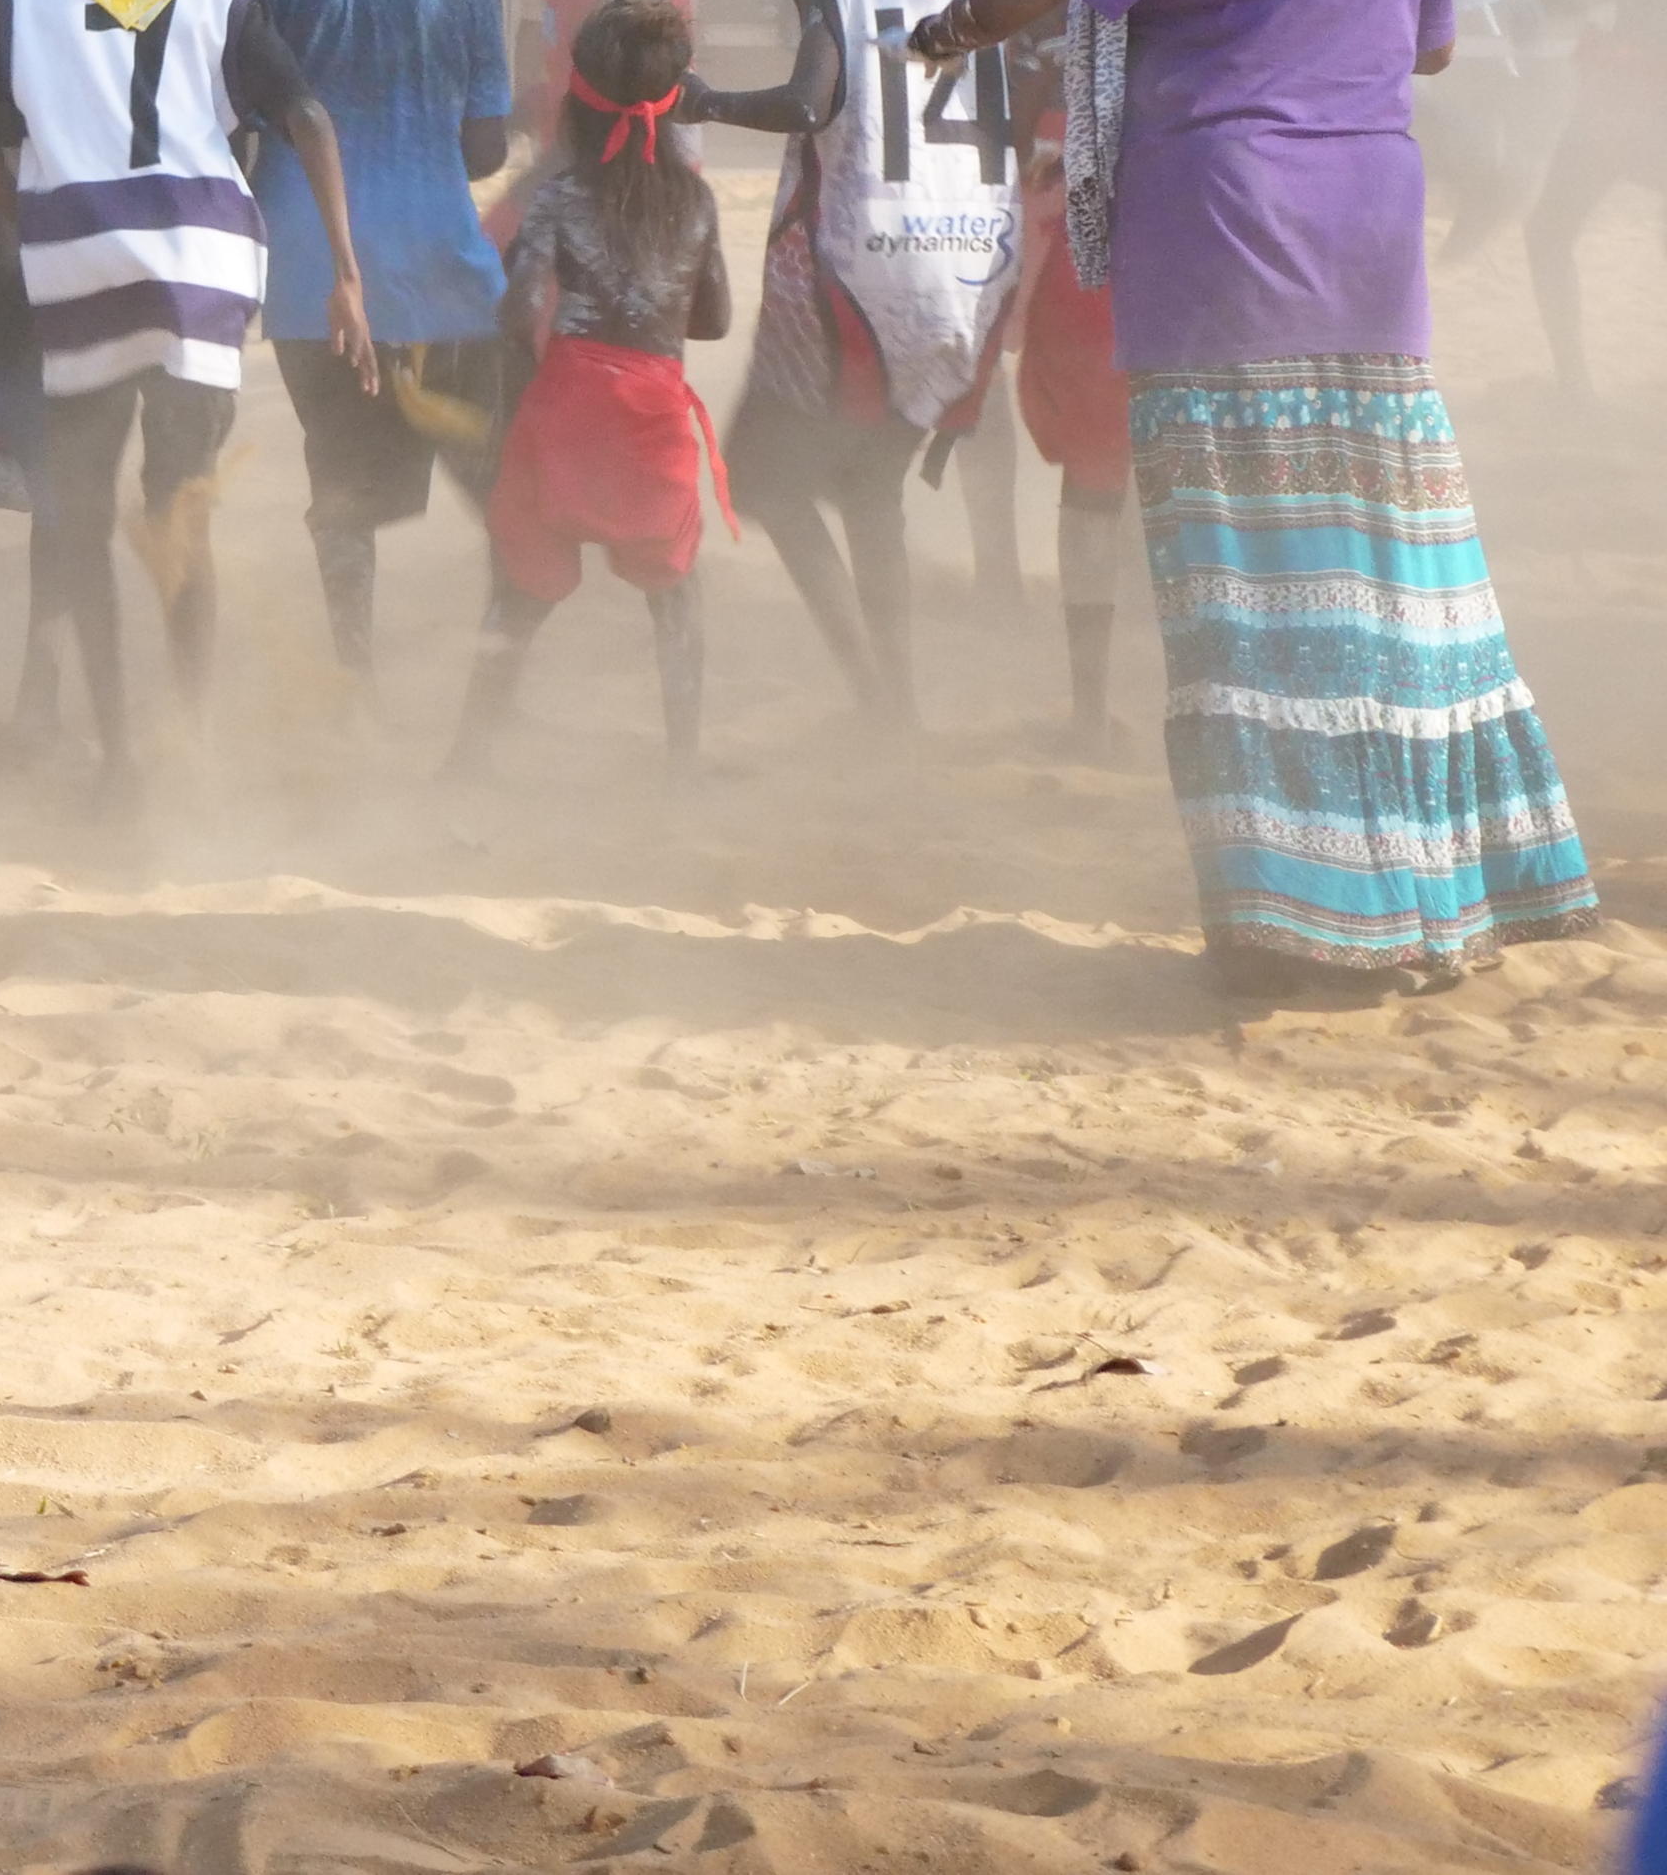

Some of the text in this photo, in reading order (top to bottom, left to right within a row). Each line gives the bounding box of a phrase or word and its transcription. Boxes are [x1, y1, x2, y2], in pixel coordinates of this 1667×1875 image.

[874, 8, 1012, 186] 14
[901, 212, 1004, 236] water
[866, 232, 994, 258] dynamics
